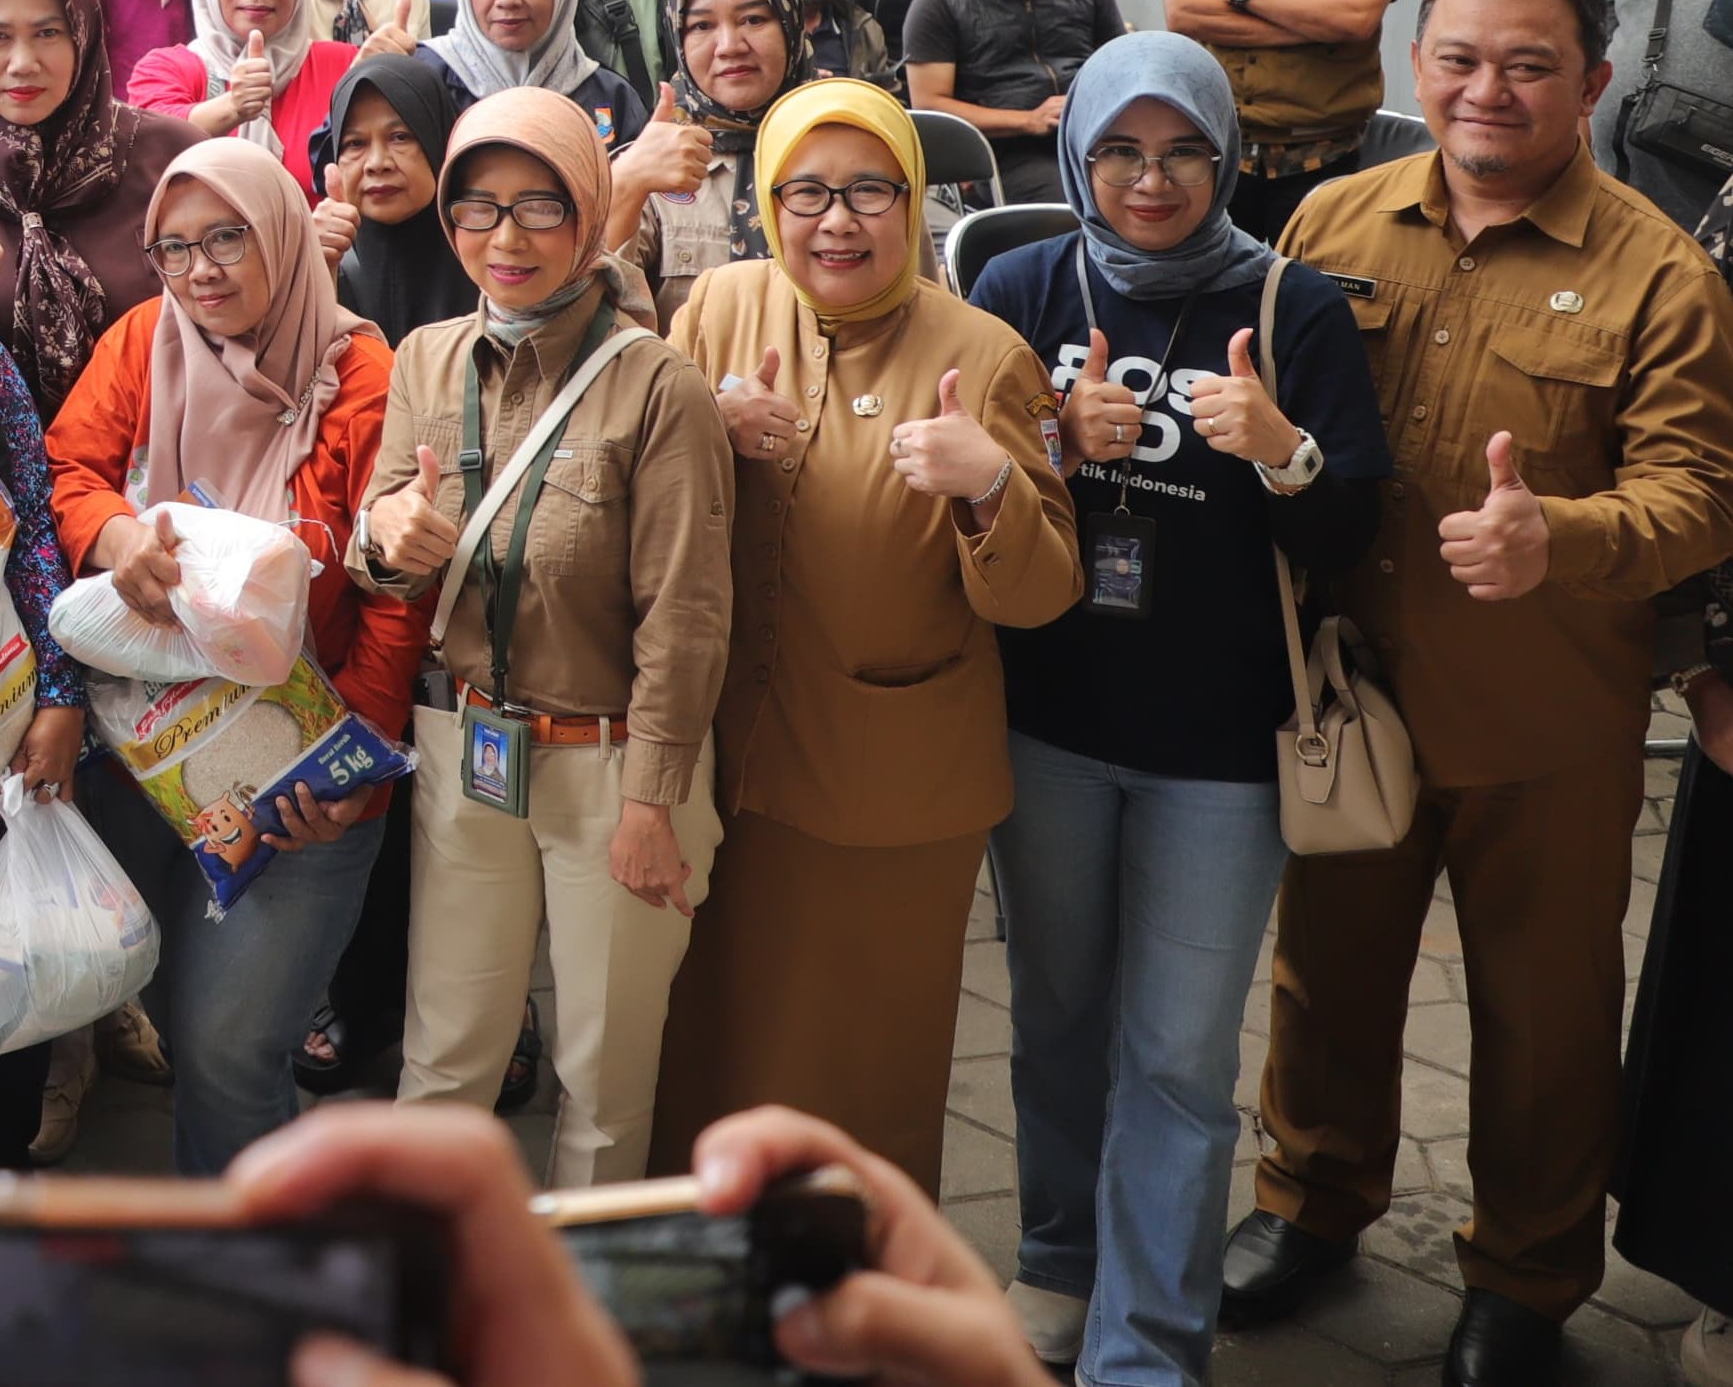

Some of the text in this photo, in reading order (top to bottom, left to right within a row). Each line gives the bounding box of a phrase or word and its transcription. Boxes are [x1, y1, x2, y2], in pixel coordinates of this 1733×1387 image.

[1079, 464, 1106, 482] tik
[329, 745, 374, 786] 5 kg
